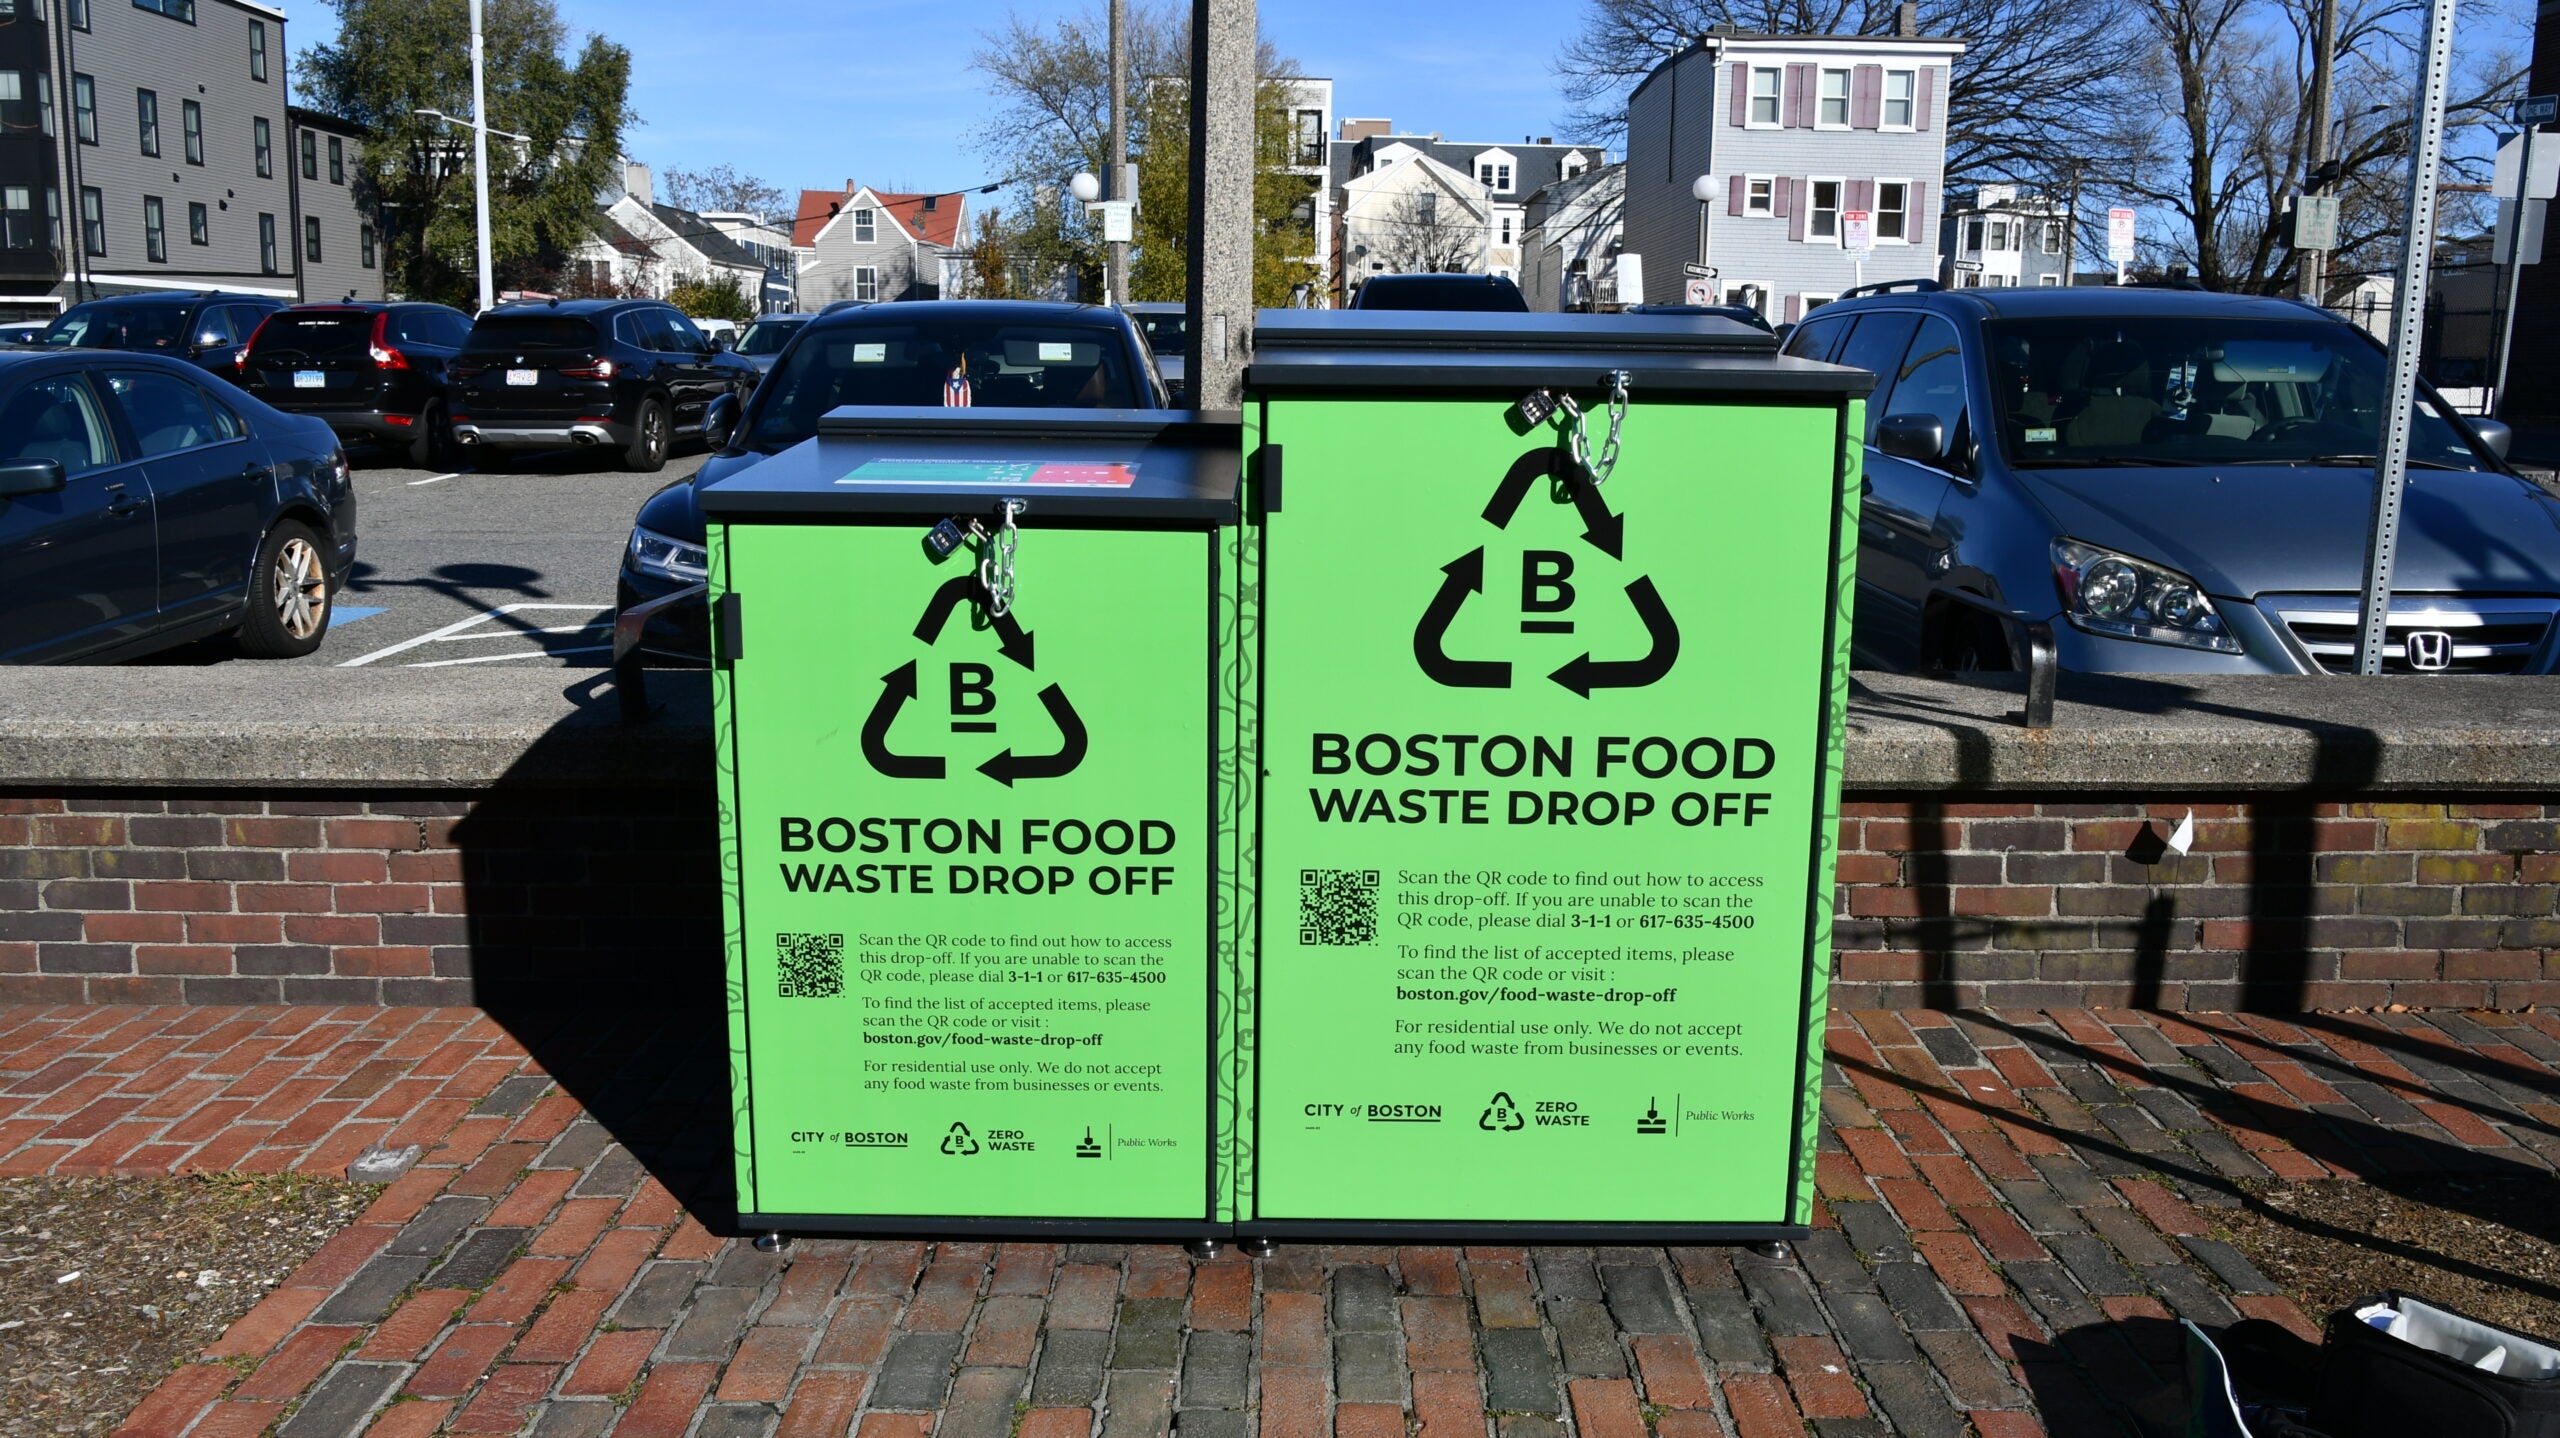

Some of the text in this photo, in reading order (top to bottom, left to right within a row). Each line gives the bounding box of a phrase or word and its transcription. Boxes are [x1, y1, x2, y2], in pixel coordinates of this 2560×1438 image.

[1521, 550, 1576, 613] B
[949, 662, 997, 716] B
[1312, 733, 1775, 779] BOSTON FOOD
[1309, 788, 1772, 827] WASTE DROP OFF
[780, 817, 1176, 855] BOSTON FOOD
[779, 863, 1174, 895] WASTE DROP OFF
[1399, 870, 1763, 888] Scan the QR code to find out how to access
[1398, 891, 1752, 910] this drop-off. If you are unable to scan the
[1398, 912, 1754, 931] QR code, please dial 3-1-1 or 617-635-4500
[860, 934, 1171, 949] Scan the QR code to find out how to access
[860, 951, 1163, 968] this drop-off. If you are unable to scan the
[1398, 944, 1734, 965] To find the list of accepted items, please
[861, 969, 1166, 985] QR code, please dial 3-1-1 or 617-635-4500
[1398, 969, 1434, 979] scan
[1440, 966, 1467, 980] the
[1473, 967, 1497, 983] QR
[1503, 967, 1543, 980] code
[1548, 971, 1566, 980] or
[1571, 968, 1605, 981] visit
[1396, 986, 1677, 1006] boston.gov/food-waste-drop-off
[862, 997, 1150, 1013] To find the list of accepted items, please
[863, 1018, 895, 1026] scan
[900, 1015, 922, 1026] the
[927, 1015, 949, 1030] QR
[953, 1015, 987, 1027] code
[992, 1019, 1007, 1027] or
[1011, 1016, 1041, 1027] visit
[1396, 1020, 1742, 1039] For residential use only. We do not accept
[863, 1032, 1103, 1049] boston.gov/food-waste-drop-off
[1394, 1040, 1742, 1057] any food waste from businesses or events.
[864, 1060, 1161, 1077] For residential use only. We do not accept
[864, 1077, 1163, 1092] any food waste from businesses or events.
[1305, 1104, 1441, 1117] CITY of BOSTON
[1536, 1102, 1577, 1112] ZERO
[1686, 1110, 1754, 1120] Public Works
[1535, 1115, 1590, 1126] WASTE
[791, 1132, 908, 1143] CITY of BOSTON
[988, 1130, 1024, 1139] ZERO
[1118, 1138, 1177, 1146] Public Works
[988, 1142, 1035, 1151] WASTE
